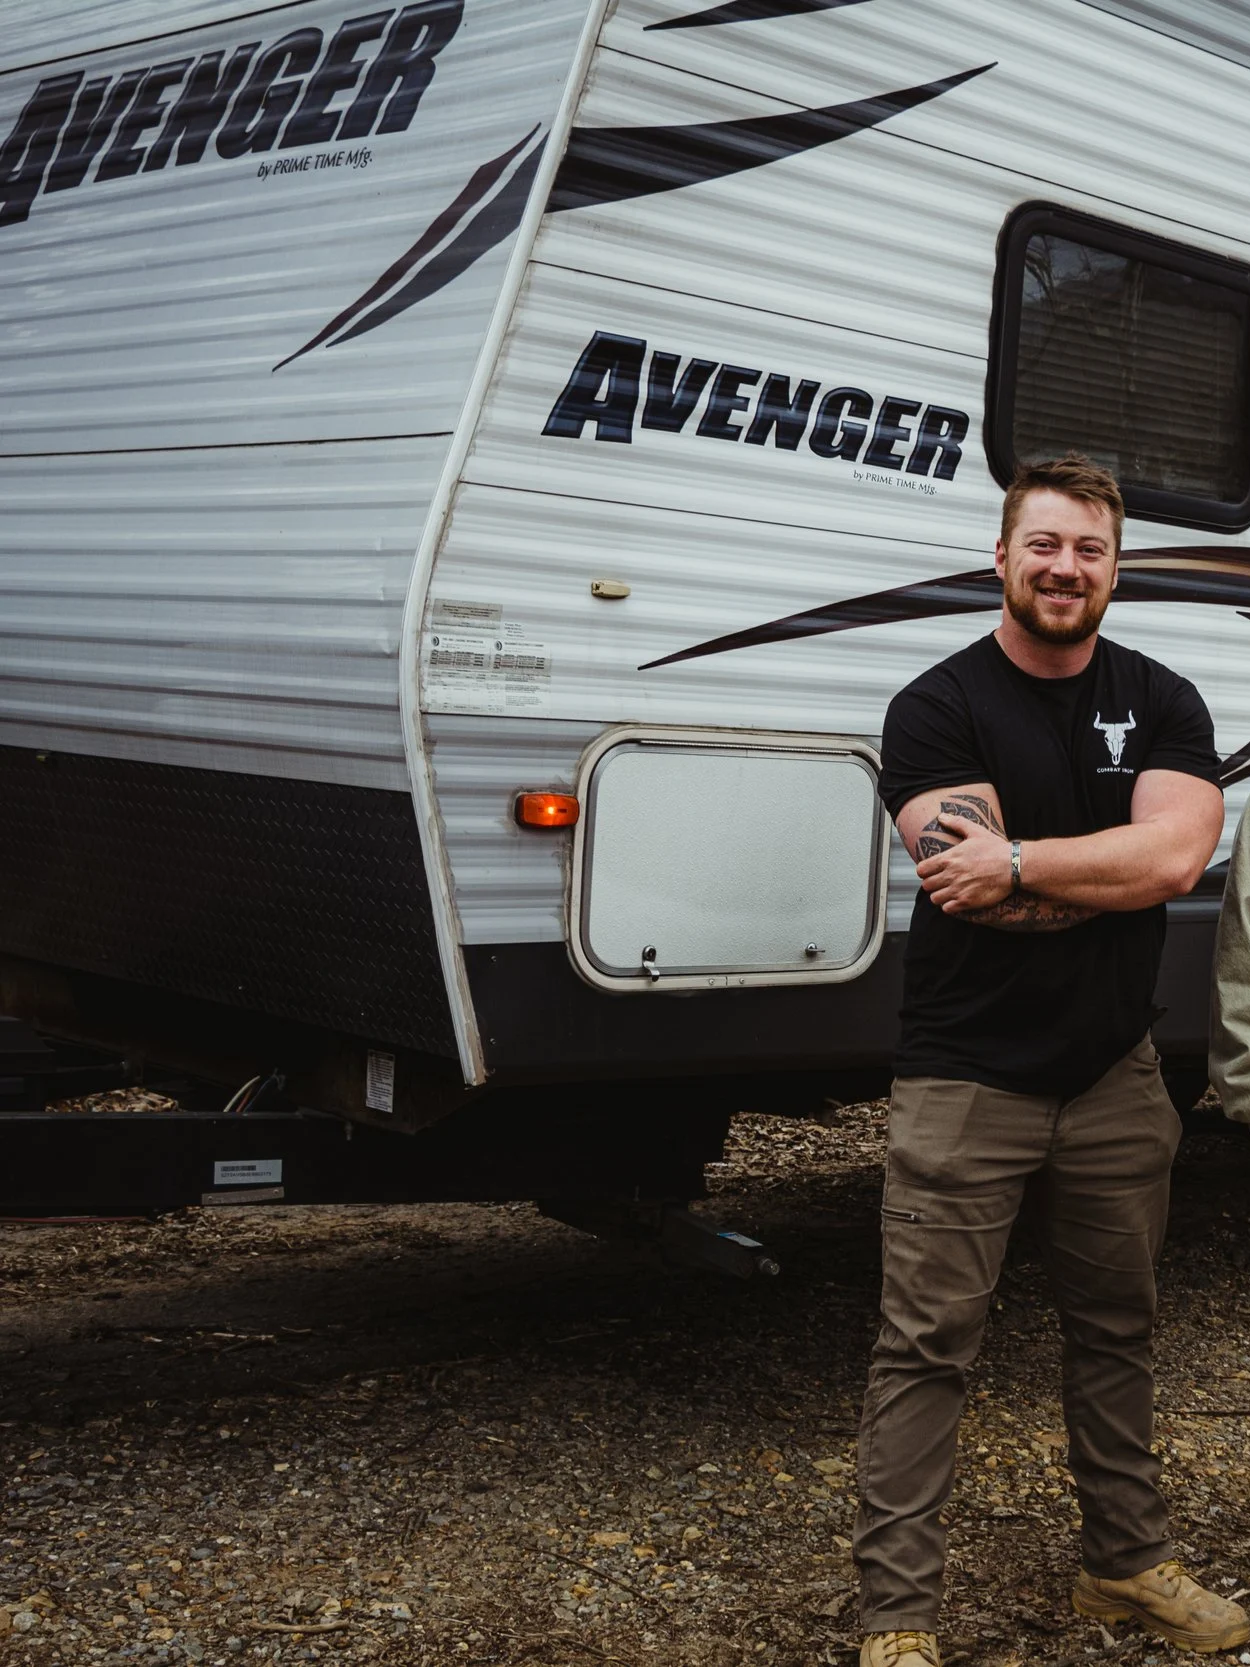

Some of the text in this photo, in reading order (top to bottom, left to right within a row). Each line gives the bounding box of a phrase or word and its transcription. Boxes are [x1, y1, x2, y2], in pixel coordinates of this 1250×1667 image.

[0, 0, 465, 227] AVENGER
[257, 146, 373, 181] by PRIME TIME Mfg.
[541, 330, 970, 482] AVENGER
[853, 469, 938, 496] by PRIME TIME Mfg.
